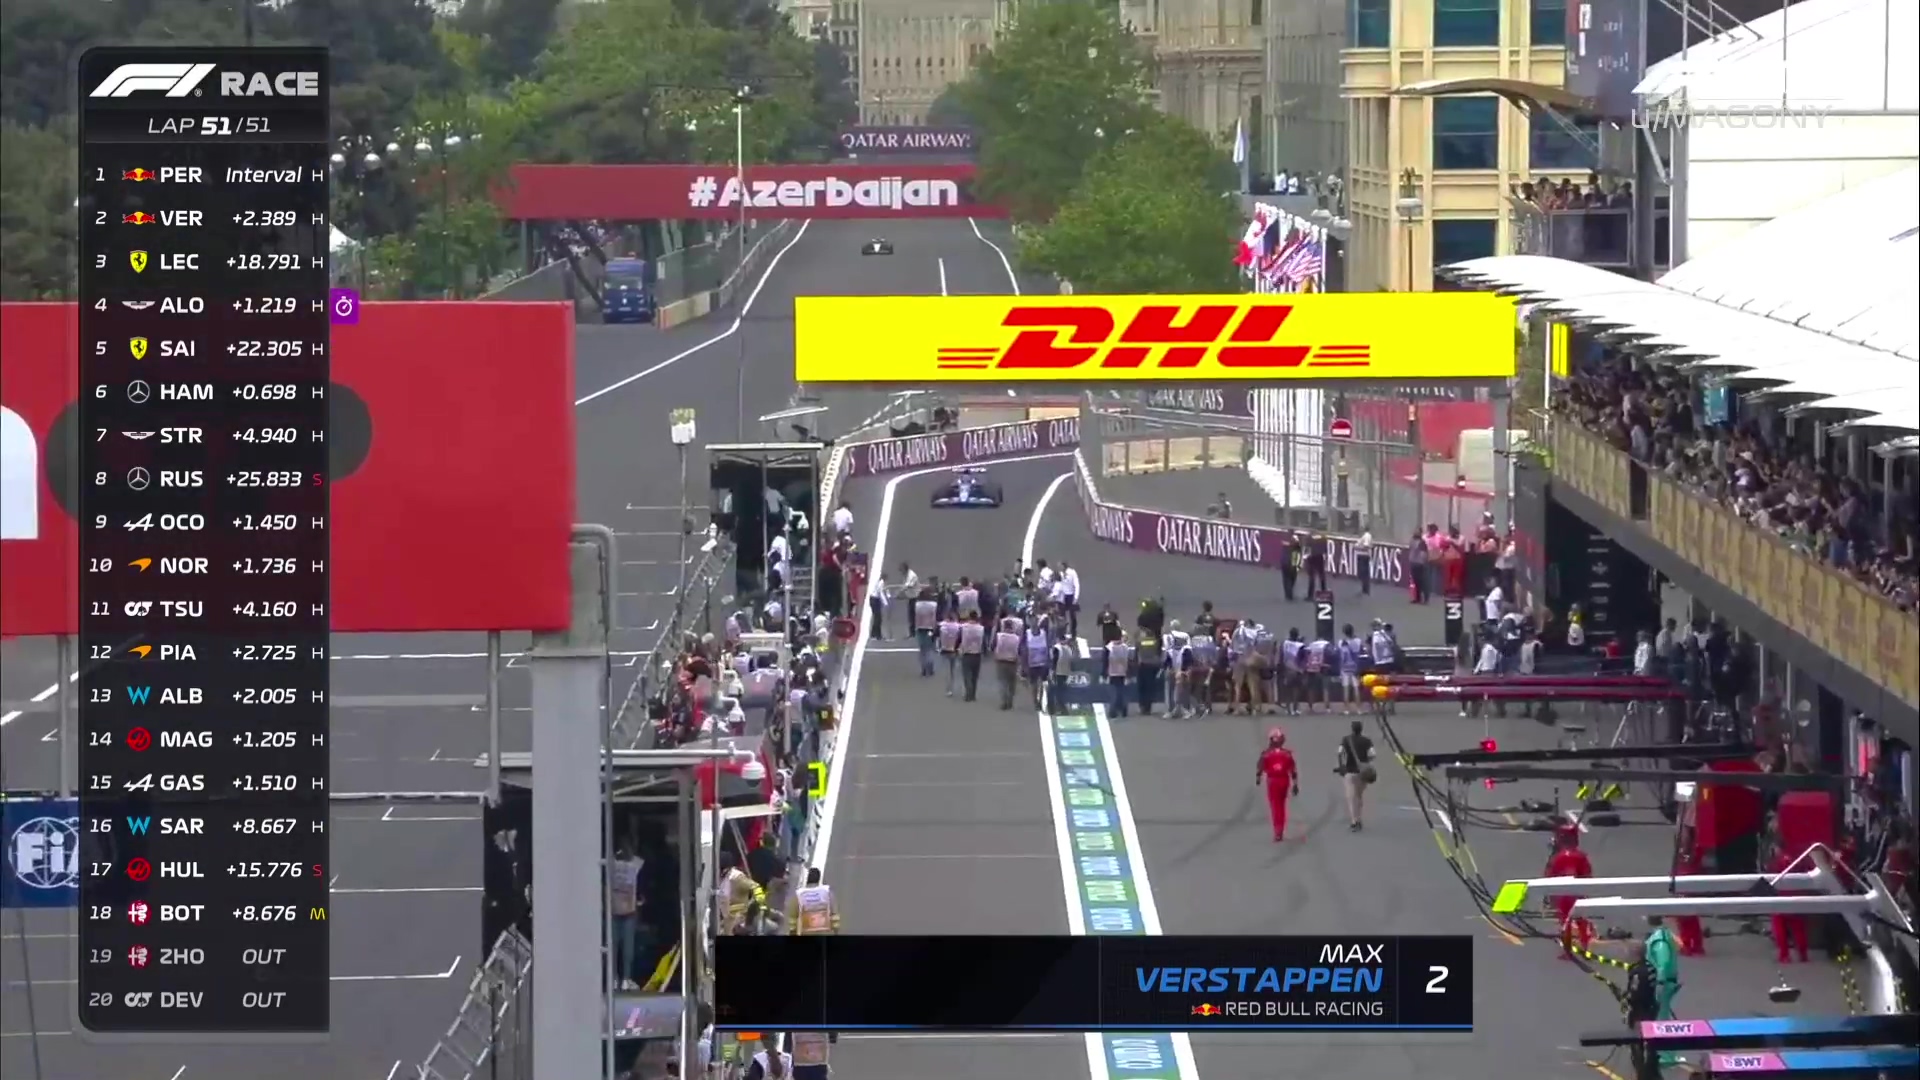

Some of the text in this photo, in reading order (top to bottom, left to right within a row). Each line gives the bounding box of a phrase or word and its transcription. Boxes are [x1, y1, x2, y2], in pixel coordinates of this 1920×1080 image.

[841, 133, 898, 147] QATAR
[688, 175, 958, 210] #Azerbaijan
[996, 305, 1309, 368] DHL
[868, 442, 903, 473] QATAR
[963, 427, 996, 459] QATAR
[1157, 516, 1201, 554] QATAR
[1204, 521, 1260, 562] AIRWAYS
[1339, 542, 1402, 582] AIAYS
[1318, 604, 1331, 619] 2
[1447, 603, 1460, 619] 3
[17, 831, 79, 873] Fi
